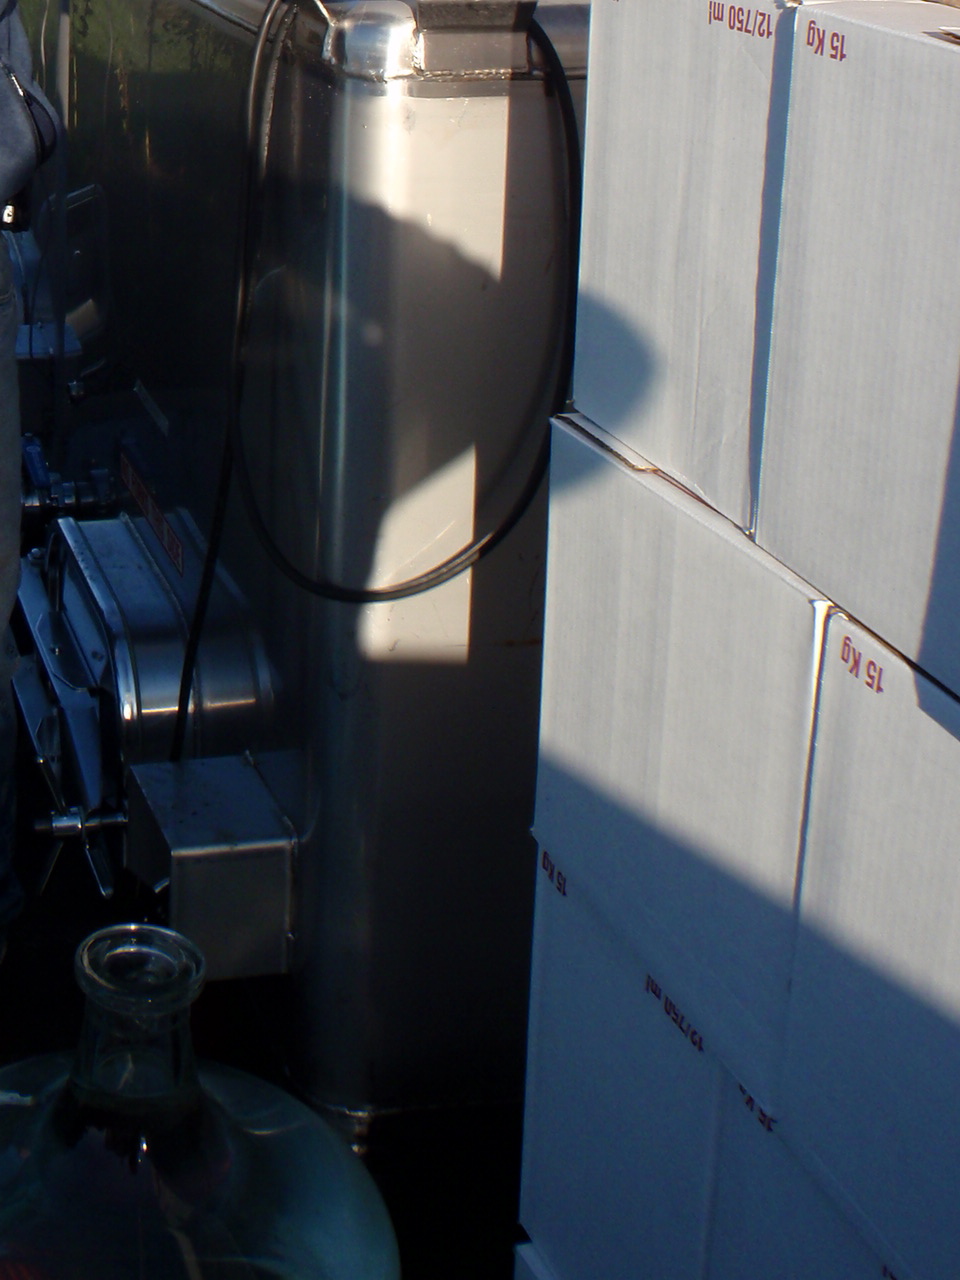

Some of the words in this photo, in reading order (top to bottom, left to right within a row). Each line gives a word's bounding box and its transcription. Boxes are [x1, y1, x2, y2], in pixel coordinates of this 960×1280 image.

[708, 1, 725, 25] ml
[728, 5, 773, 39] 12/750
[806, 20, 825, 56] Kg
[830, 32, 847, 62] 15
[841, 635, 862, 678] Kg
[865, 660, 884, 694] 15
[542, 851, 555, 883] Kg
[556, 871, 567, 896] 15
